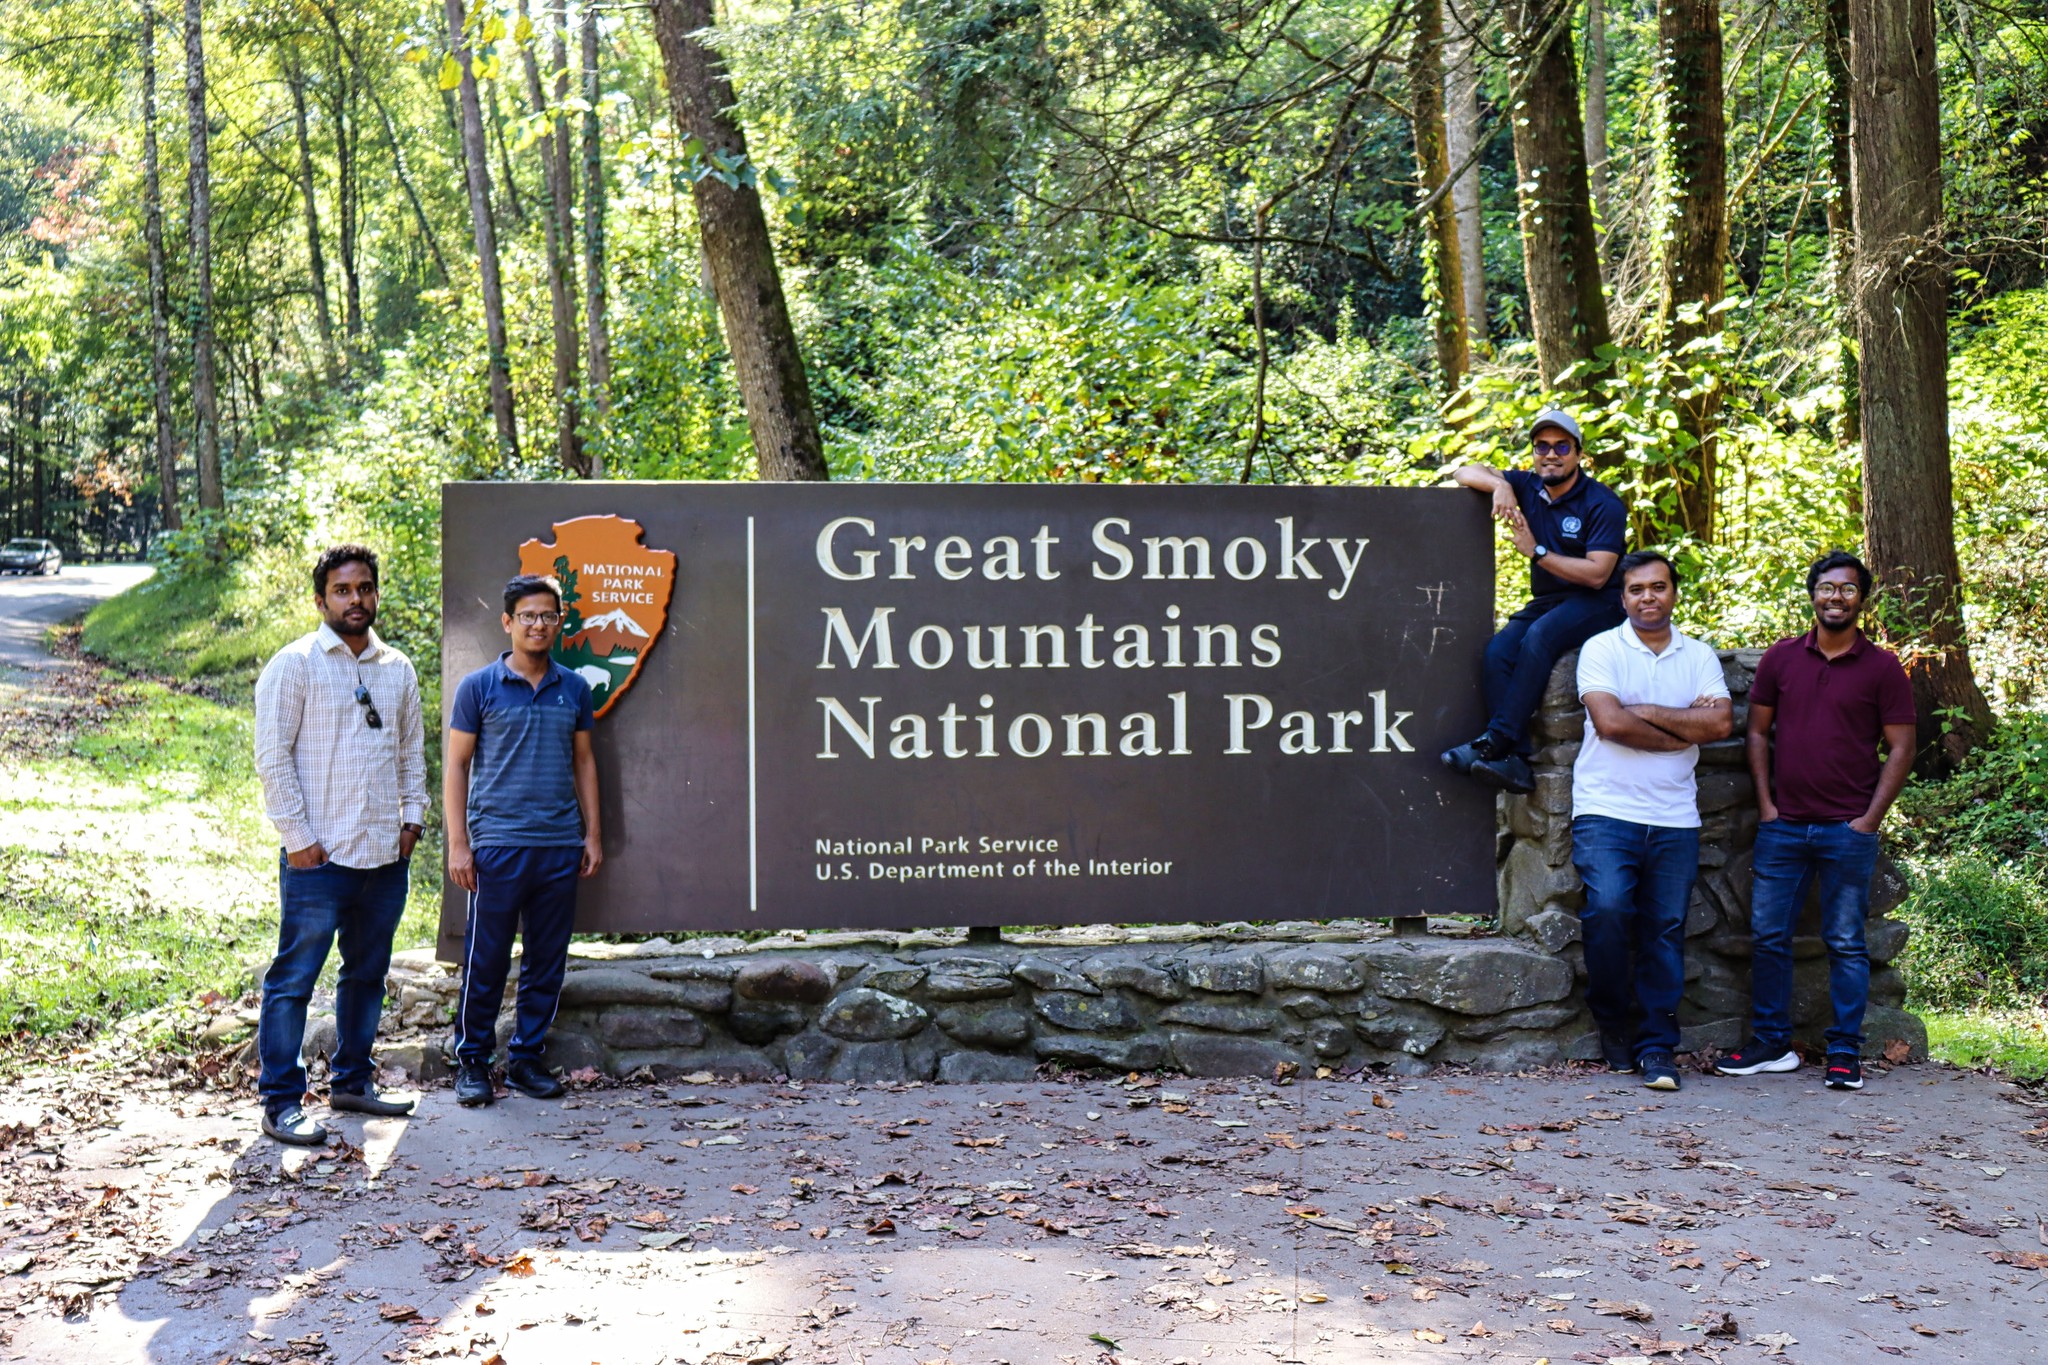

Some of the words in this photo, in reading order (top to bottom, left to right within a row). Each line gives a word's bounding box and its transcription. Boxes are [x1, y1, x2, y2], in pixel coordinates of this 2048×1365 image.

[816, 516, 1061, 581] Great
[1092, 516, 1370, 601] Smoky
[583, 563, 665, 578] NATIONAL
[603, 578, 644, 590] PARK
[592, 591, 654, 605] SERVICE
[816, 604, 1282, 670] Mountains
[816, 691, 1192, 760] National
[1223, 689, 1416, 755] Park
[815, 836, 912, 856] National
[921, 835, 970, 854] Park
[978, 836, 1059, 854] Service
[815, 863, 859, 881] U.S.
[869, 861, 1005, 883] Department
[1012, 858, 1036, 877] of
[1043, 858, 1081, 877] the
[1089, 858, 1173, 876] Interior
